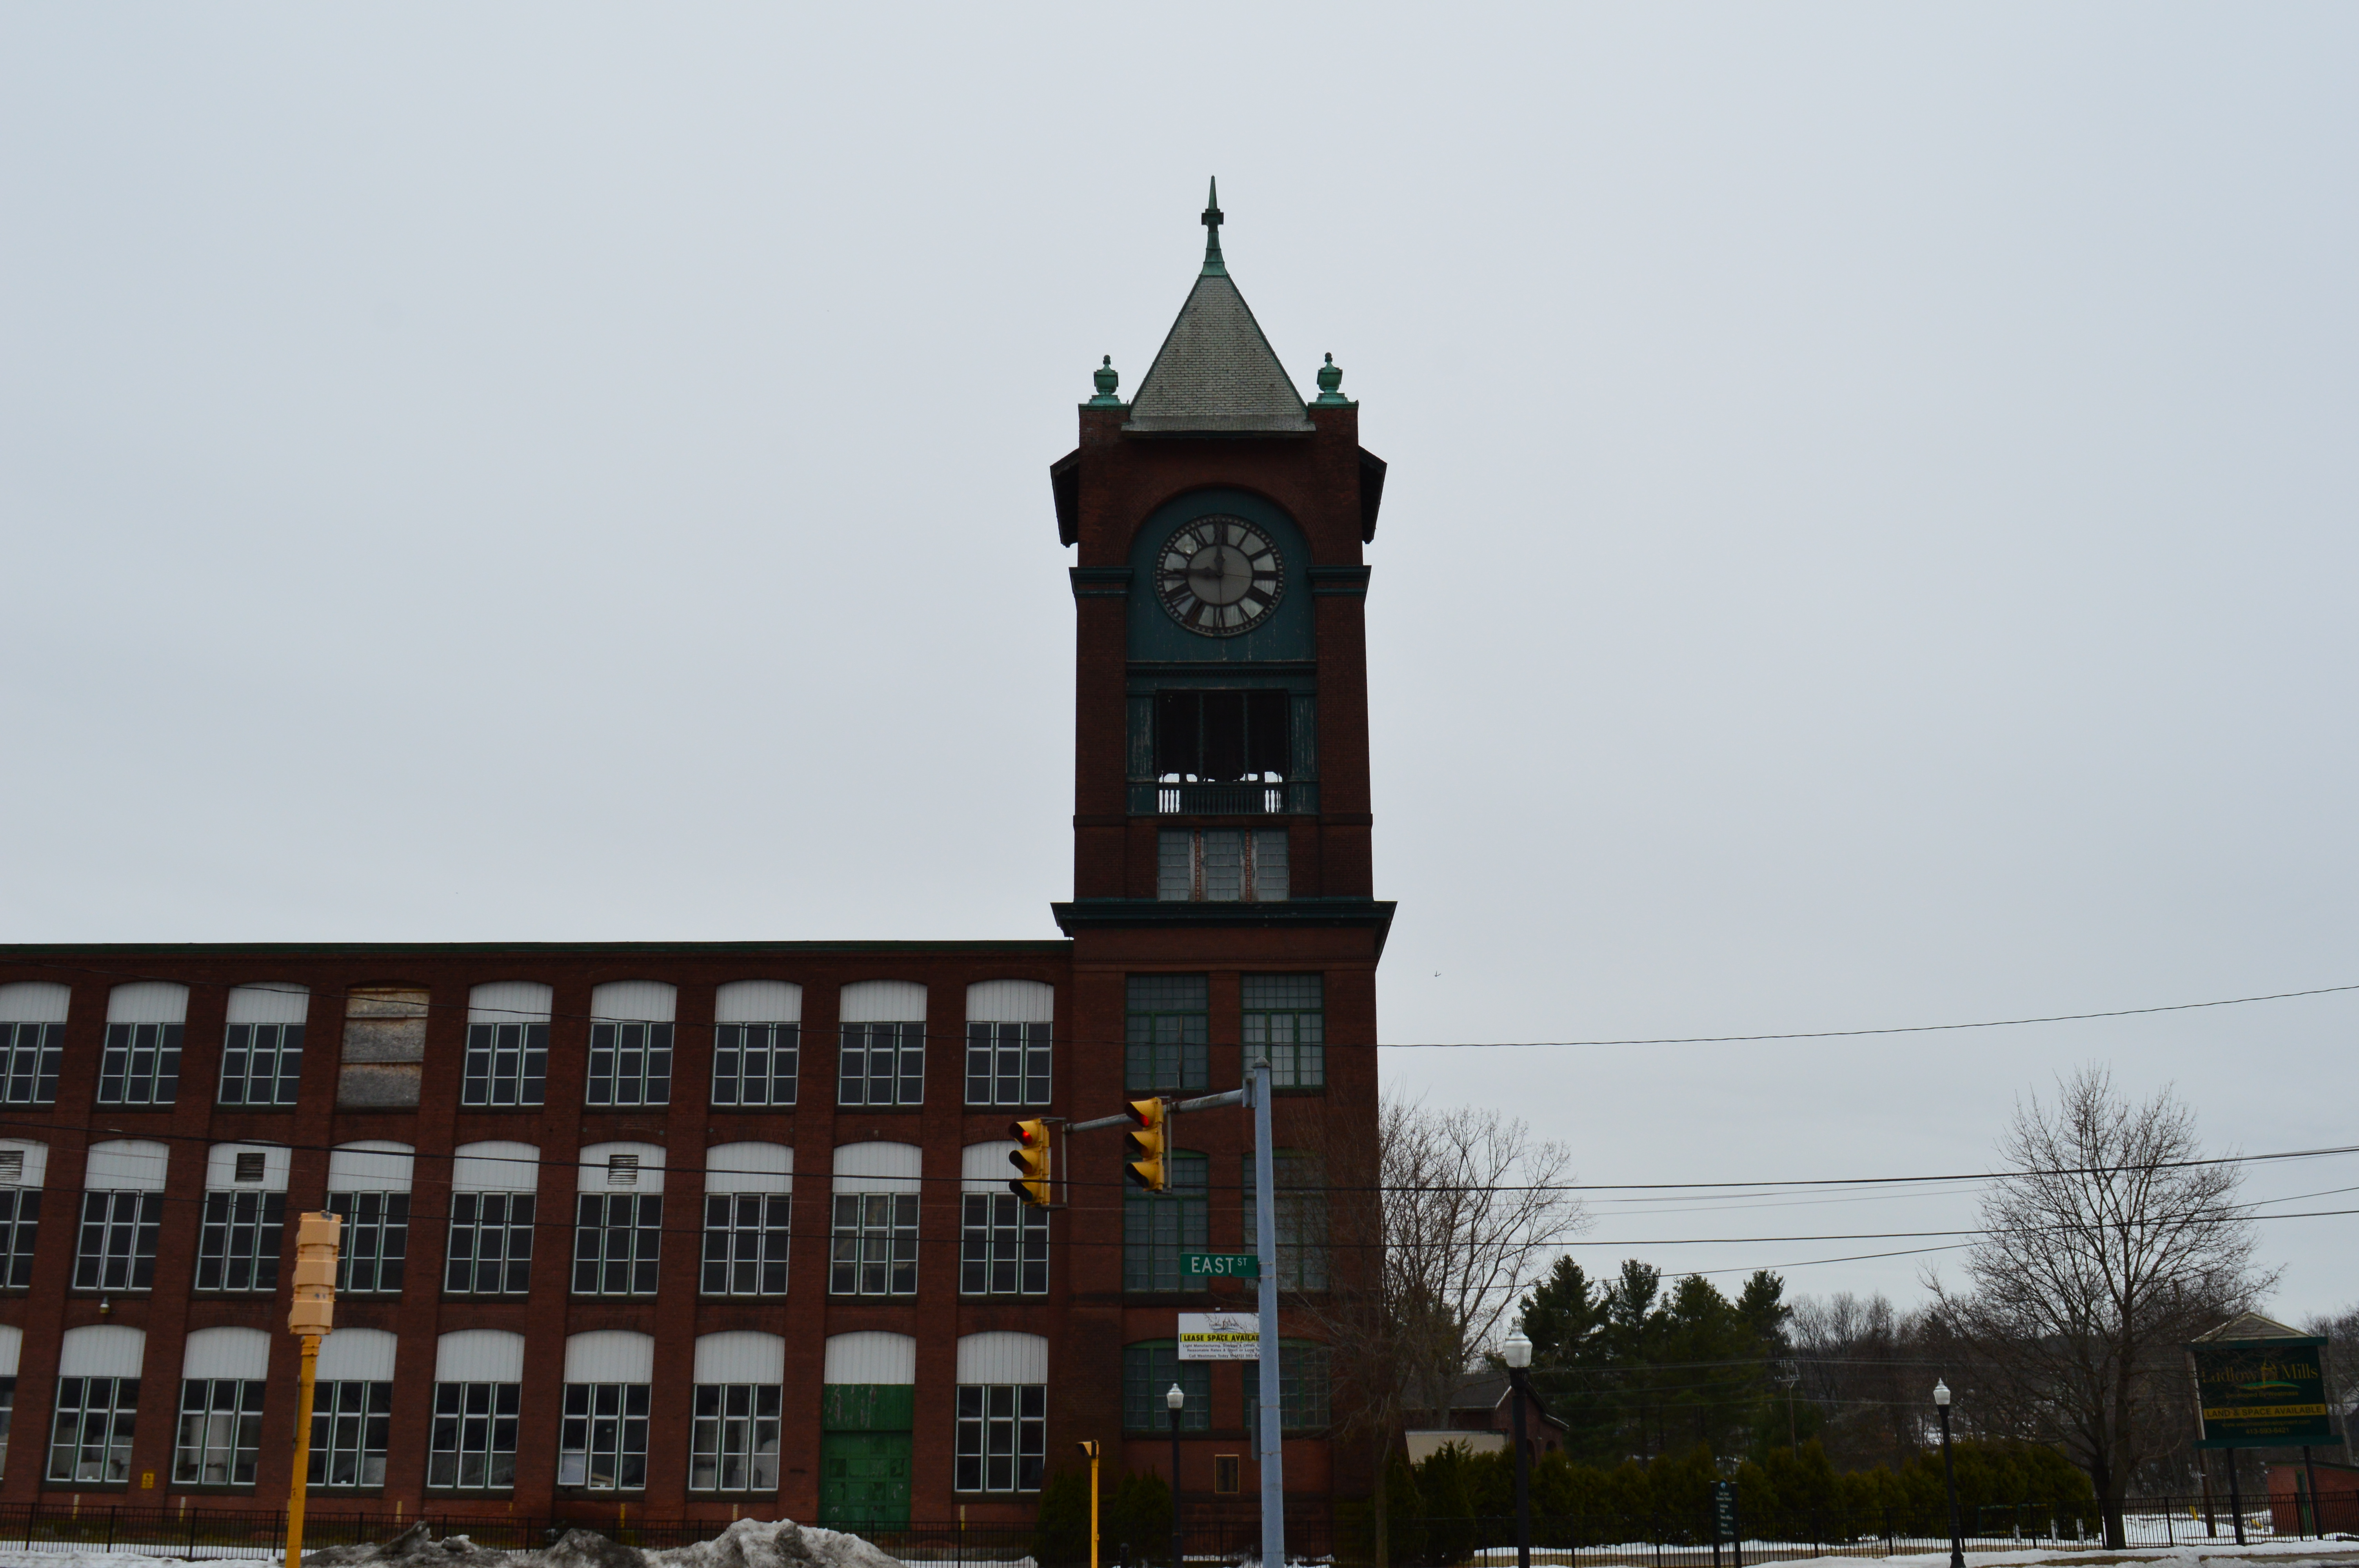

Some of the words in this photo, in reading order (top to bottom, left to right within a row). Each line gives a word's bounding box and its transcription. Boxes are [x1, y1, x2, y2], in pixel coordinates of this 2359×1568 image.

[1192, 1257, 1234, 1273] EAST
[1238, 1258, 1247, 1266] ST
[2281, 1363, 2318, 1379] Mills
[2275, 1406, 2322, 1414] AVAILABLE
